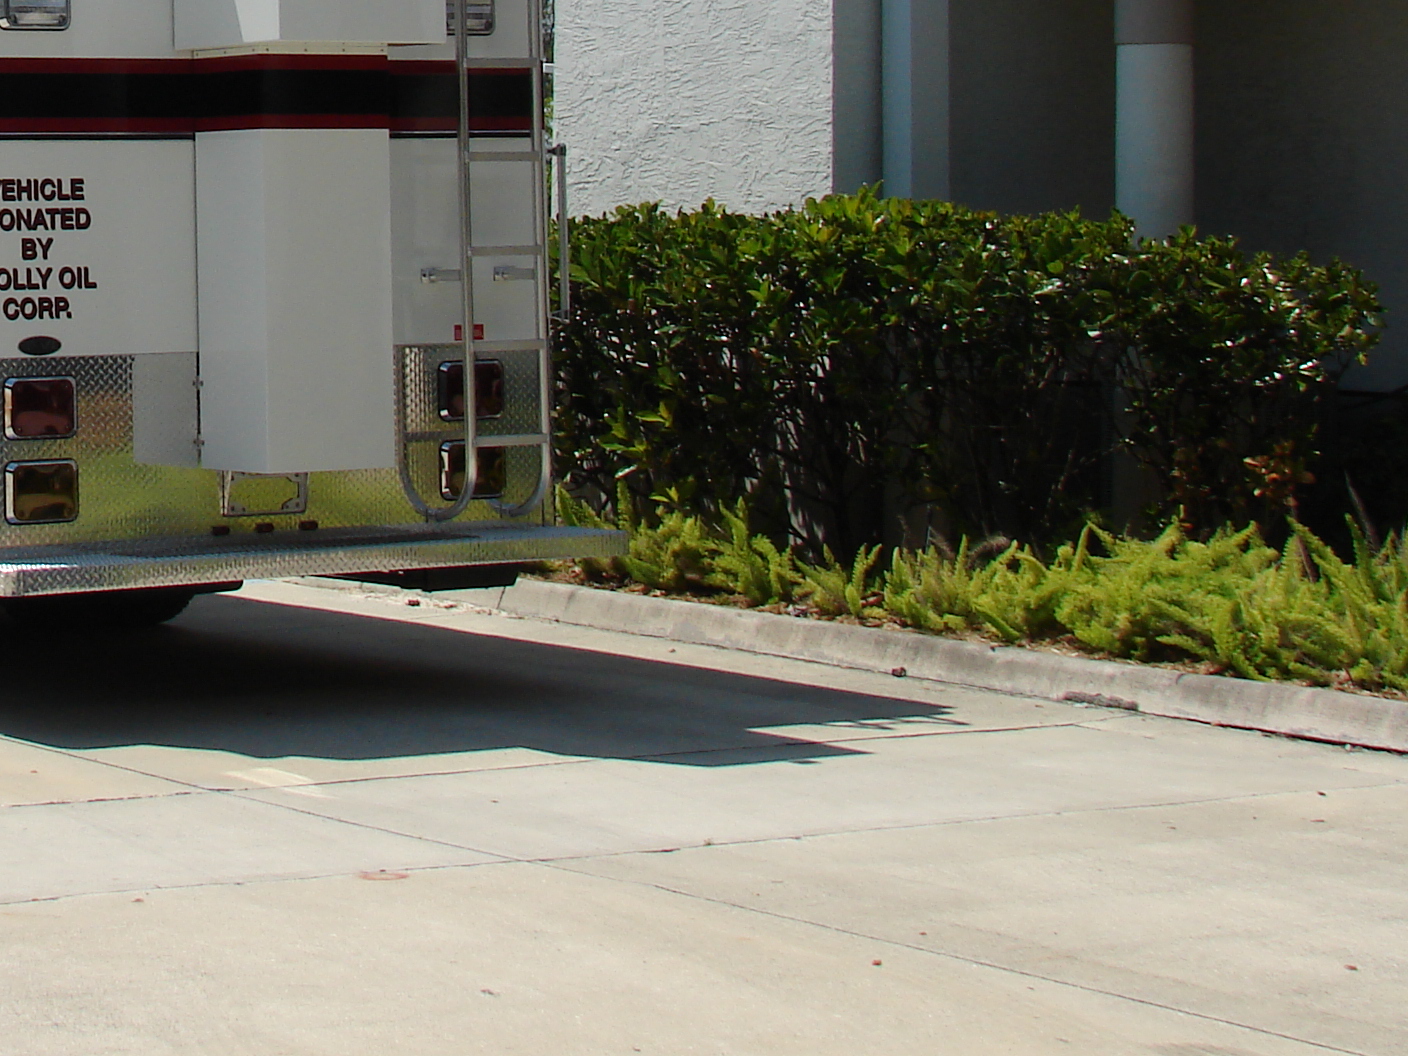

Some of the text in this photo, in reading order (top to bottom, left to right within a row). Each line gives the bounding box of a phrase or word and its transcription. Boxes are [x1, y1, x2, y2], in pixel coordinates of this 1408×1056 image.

[21, 237, 54, 261] BY
[58, 266, 98, 290] OIL
[2, 296, 73, 320] CORP.
